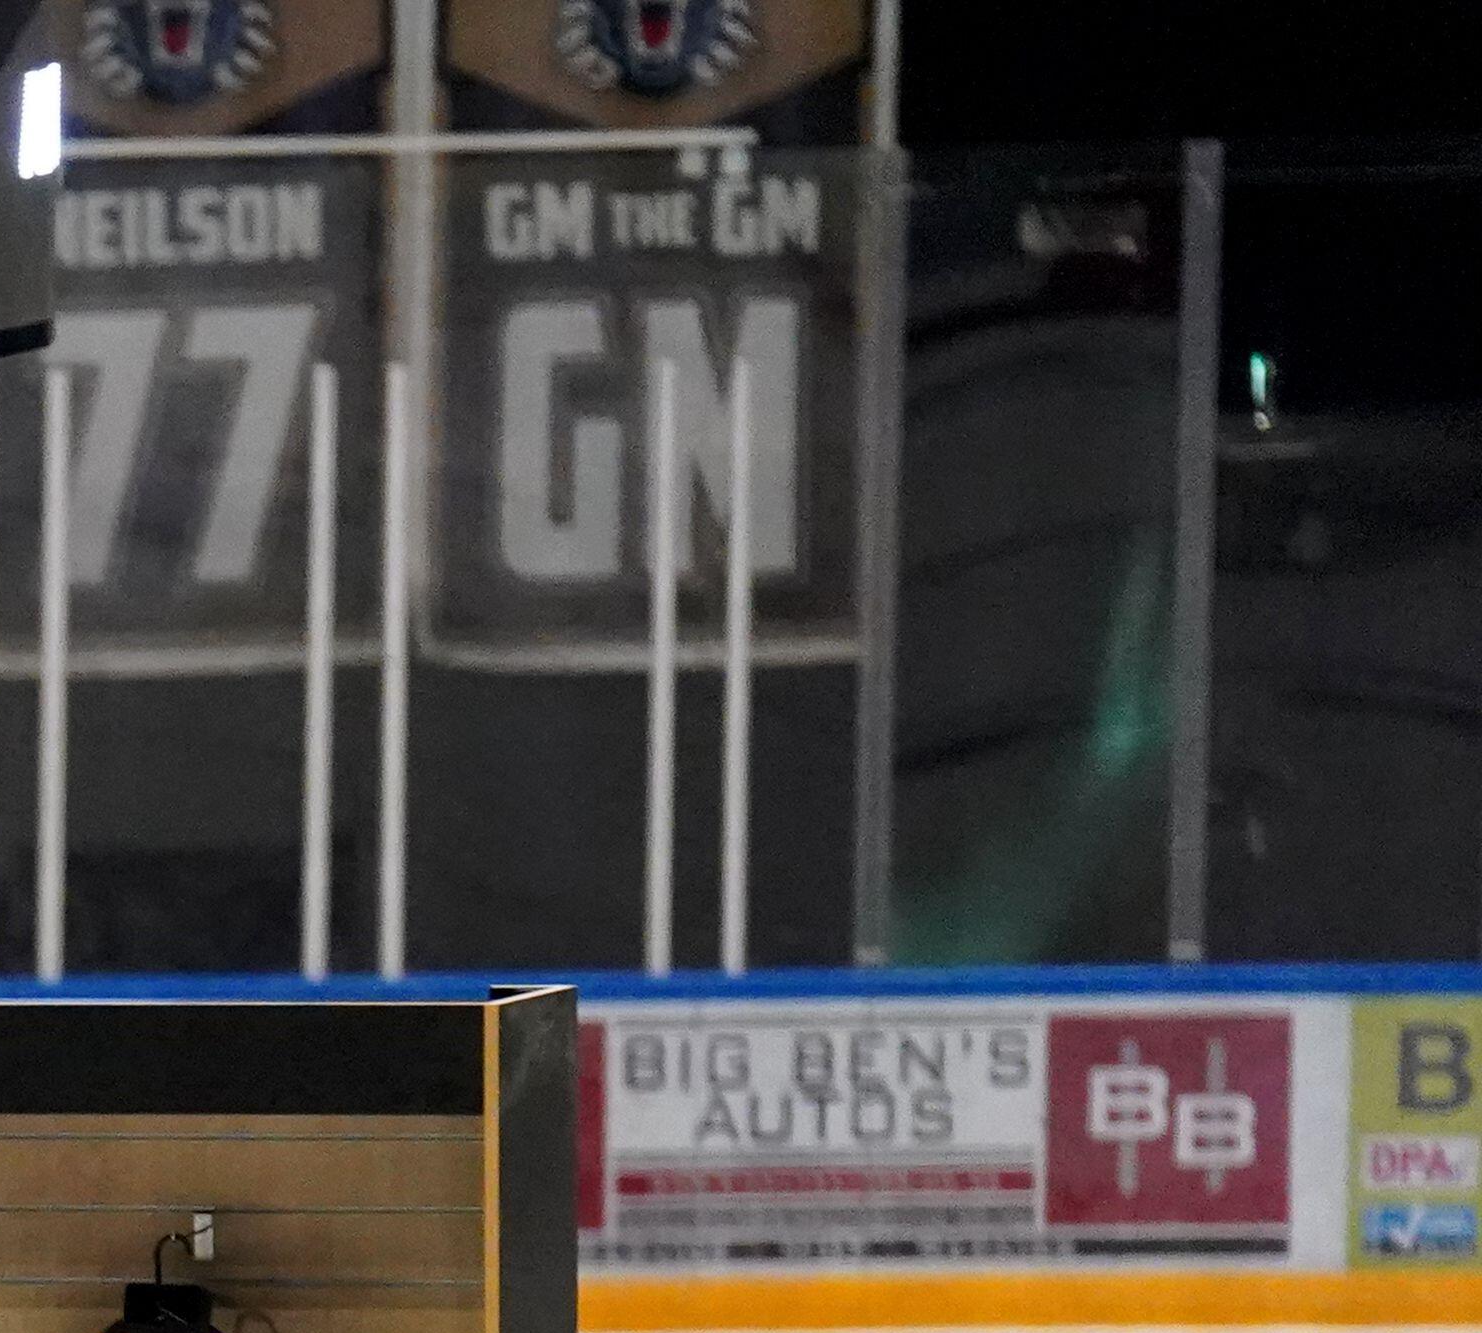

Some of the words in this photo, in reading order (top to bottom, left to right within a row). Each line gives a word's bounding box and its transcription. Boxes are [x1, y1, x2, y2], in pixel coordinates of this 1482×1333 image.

[485, 183, 594, 261] GM
[612, 192, 696, 248] THE
[712, 177, 820, 260] GM
[53, 300, 318, 586] 77
[498, 298, 800, 583] GM
[624, 1033, 750, 1093] BIG
[792, 1029, 1032, 1094] BEN'S
[694, 1088, 954, 1143] AUTOS
